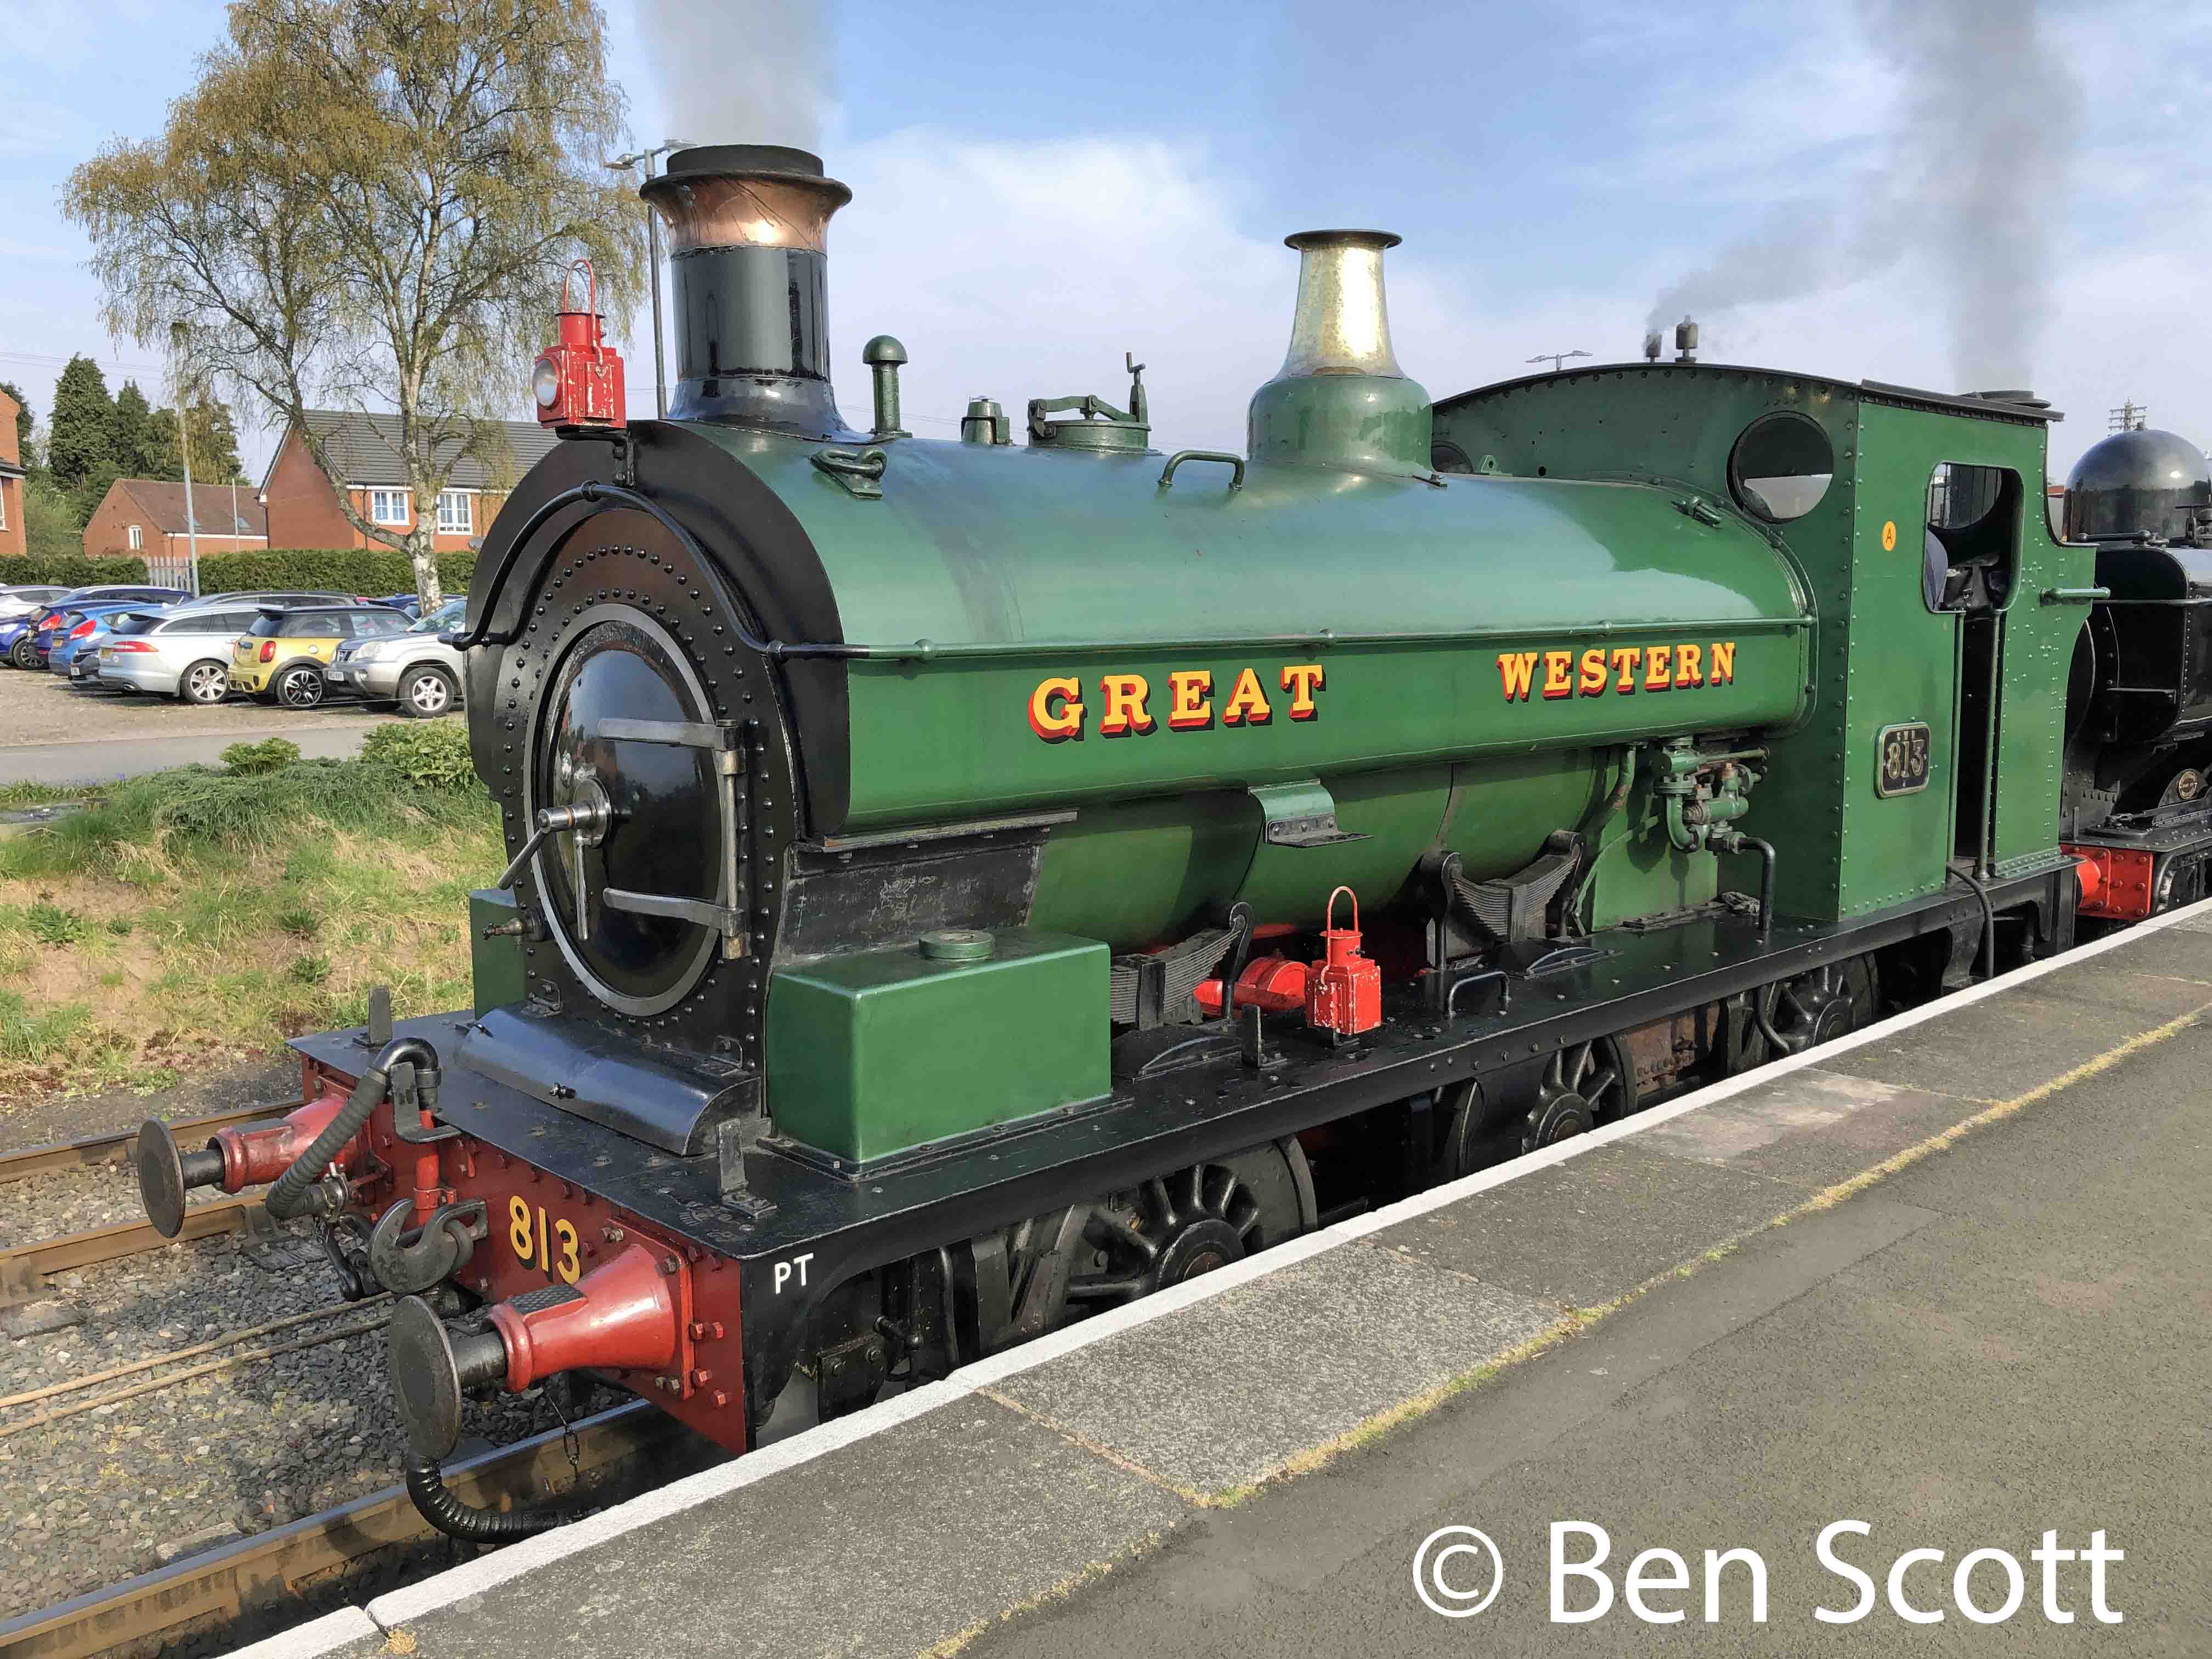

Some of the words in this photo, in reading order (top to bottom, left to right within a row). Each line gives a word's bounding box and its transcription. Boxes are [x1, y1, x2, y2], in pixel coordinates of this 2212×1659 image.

[1028, 664, 1326, 744] GREAT
[1497, 642, 1736, 703] WESTERN
[1887, 739, 1924, 780] 813
[510, 1195, 582, 1284] 813
[774, 1252, 814, 1294] PT
